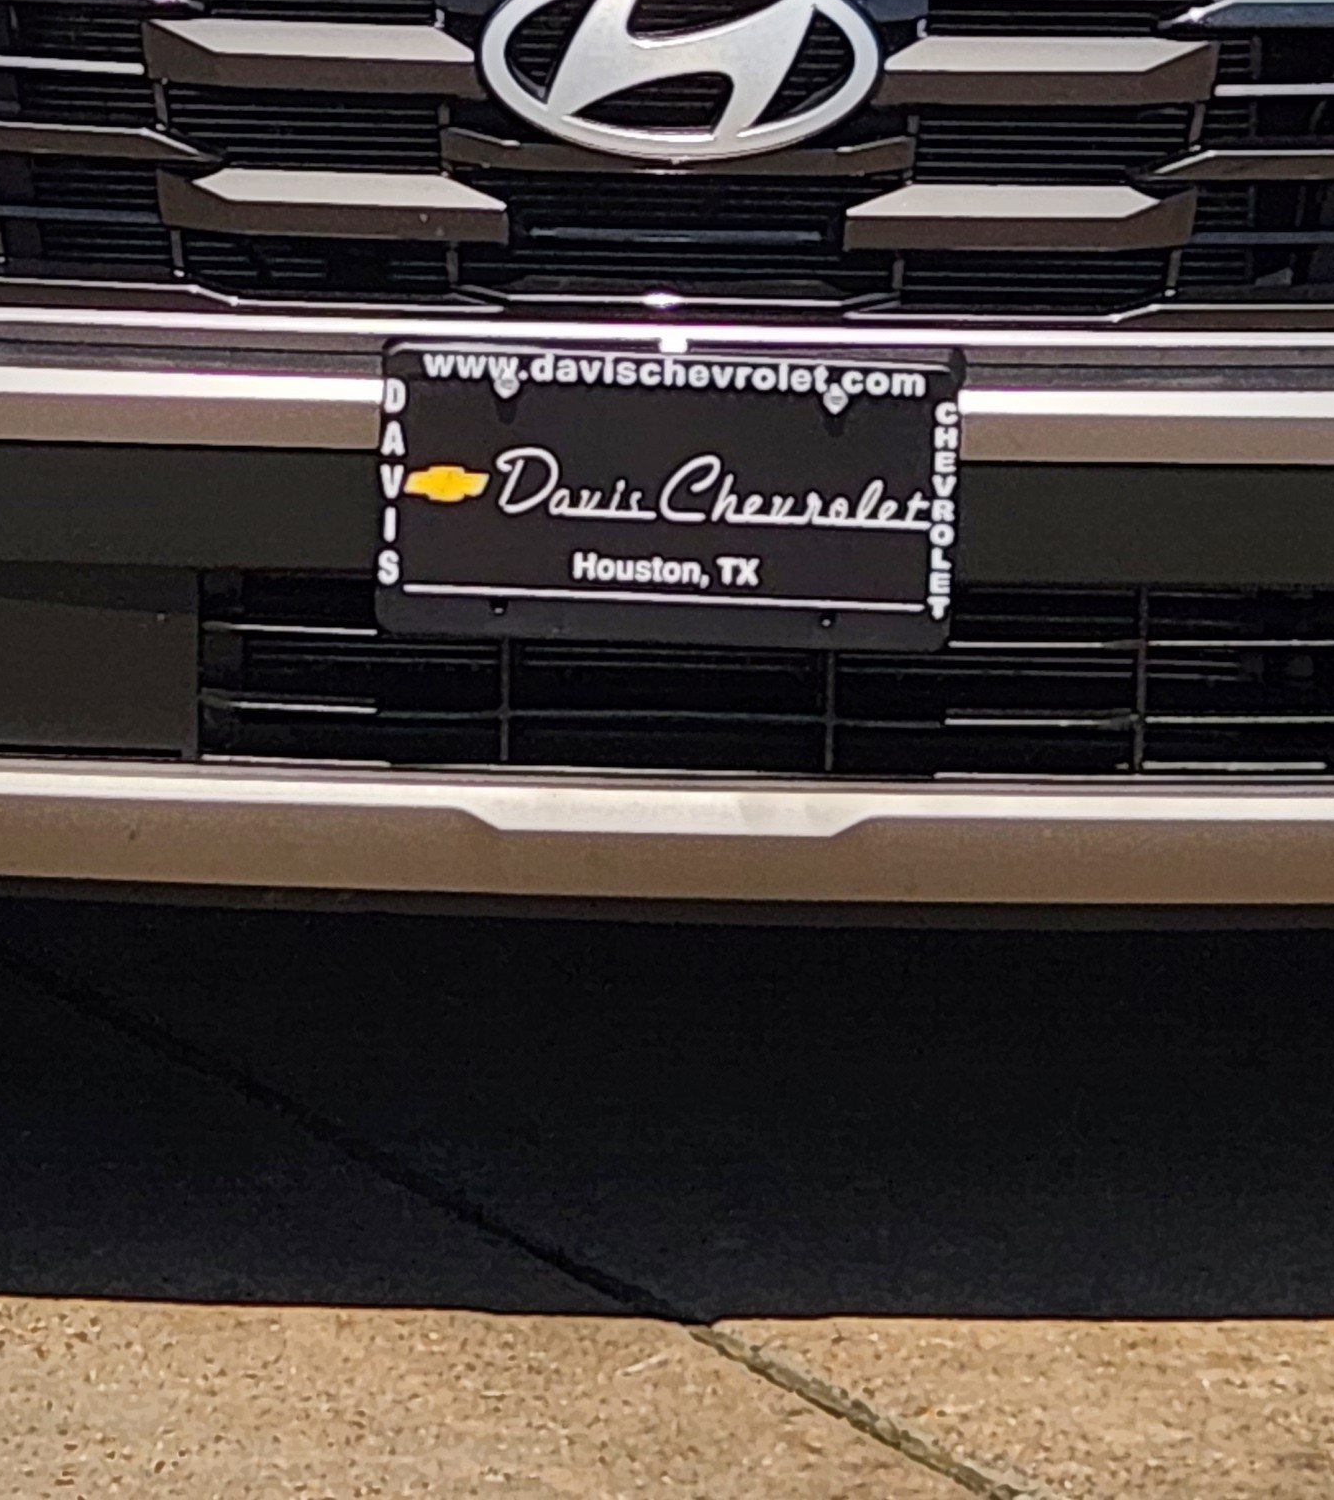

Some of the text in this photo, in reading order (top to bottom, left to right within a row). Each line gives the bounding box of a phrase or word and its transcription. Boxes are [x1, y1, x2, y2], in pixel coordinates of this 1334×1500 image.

[423, 353, 927, 397] www.davischevrolet.com
[377, 377, 407, 585] DAVIS
[496, 447, 932, 530] Davis Chevrolet
[927, 401, 959, 620] CHEVROLET
[572, 551, 760, 589] Houston, TX
